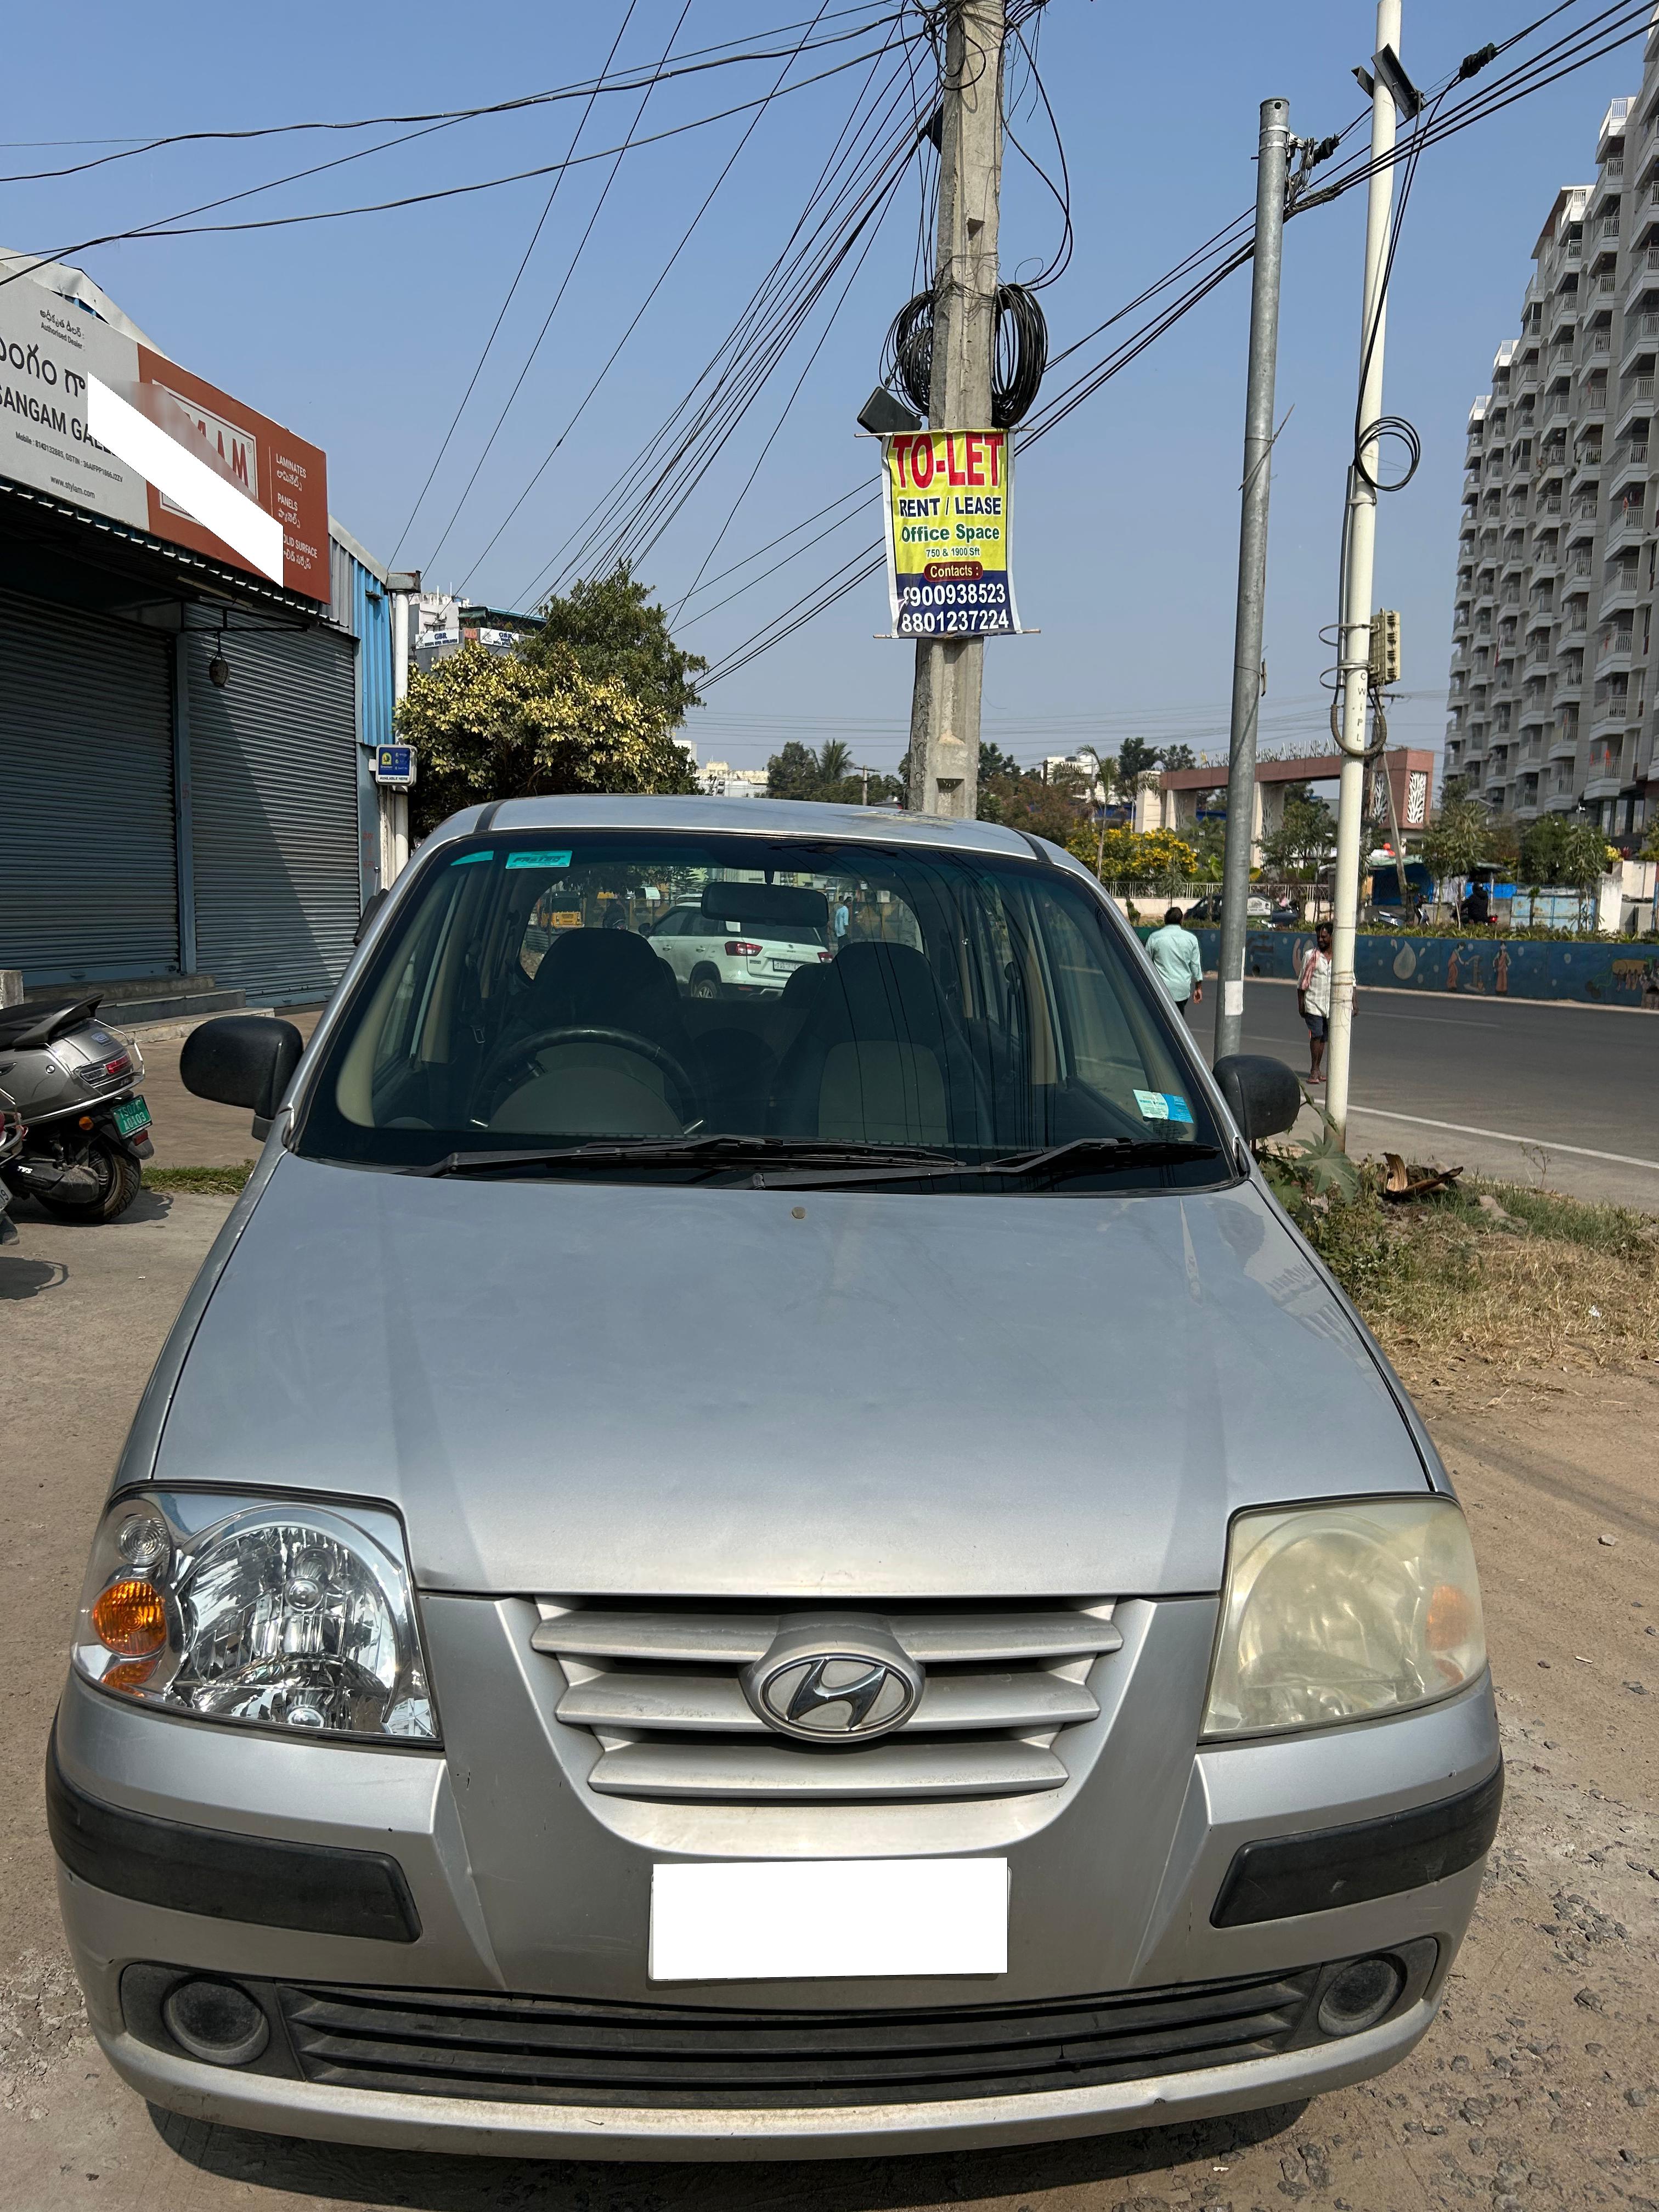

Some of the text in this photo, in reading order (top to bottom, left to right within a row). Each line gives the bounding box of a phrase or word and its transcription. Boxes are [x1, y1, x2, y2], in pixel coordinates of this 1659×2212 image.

[41, 321, 67, 341] Authorised
[67, 336, 82, 349] Dealer
[0, 385, 66, 435] ANGAM
[276, 453, 307, 478] LAMINATES
[892, 432, 1004, 488] TO-LET
[50, 476, 95, 499] www.stylam.com
[278, 493, 298, 512] PANELS
[899, 498, 940, 517] RENT
[955, 496, 1002, 515] LEASE
[901, 523, 1000, 543] Office Space
[295, 539, 318, 558] SURFACE
[926, 549, 940, 557] 750
[951, 548, 968, 556] 1900
[969, 547, 980, 556] Sft
[901, 609, 1009, 633] 8801237224
